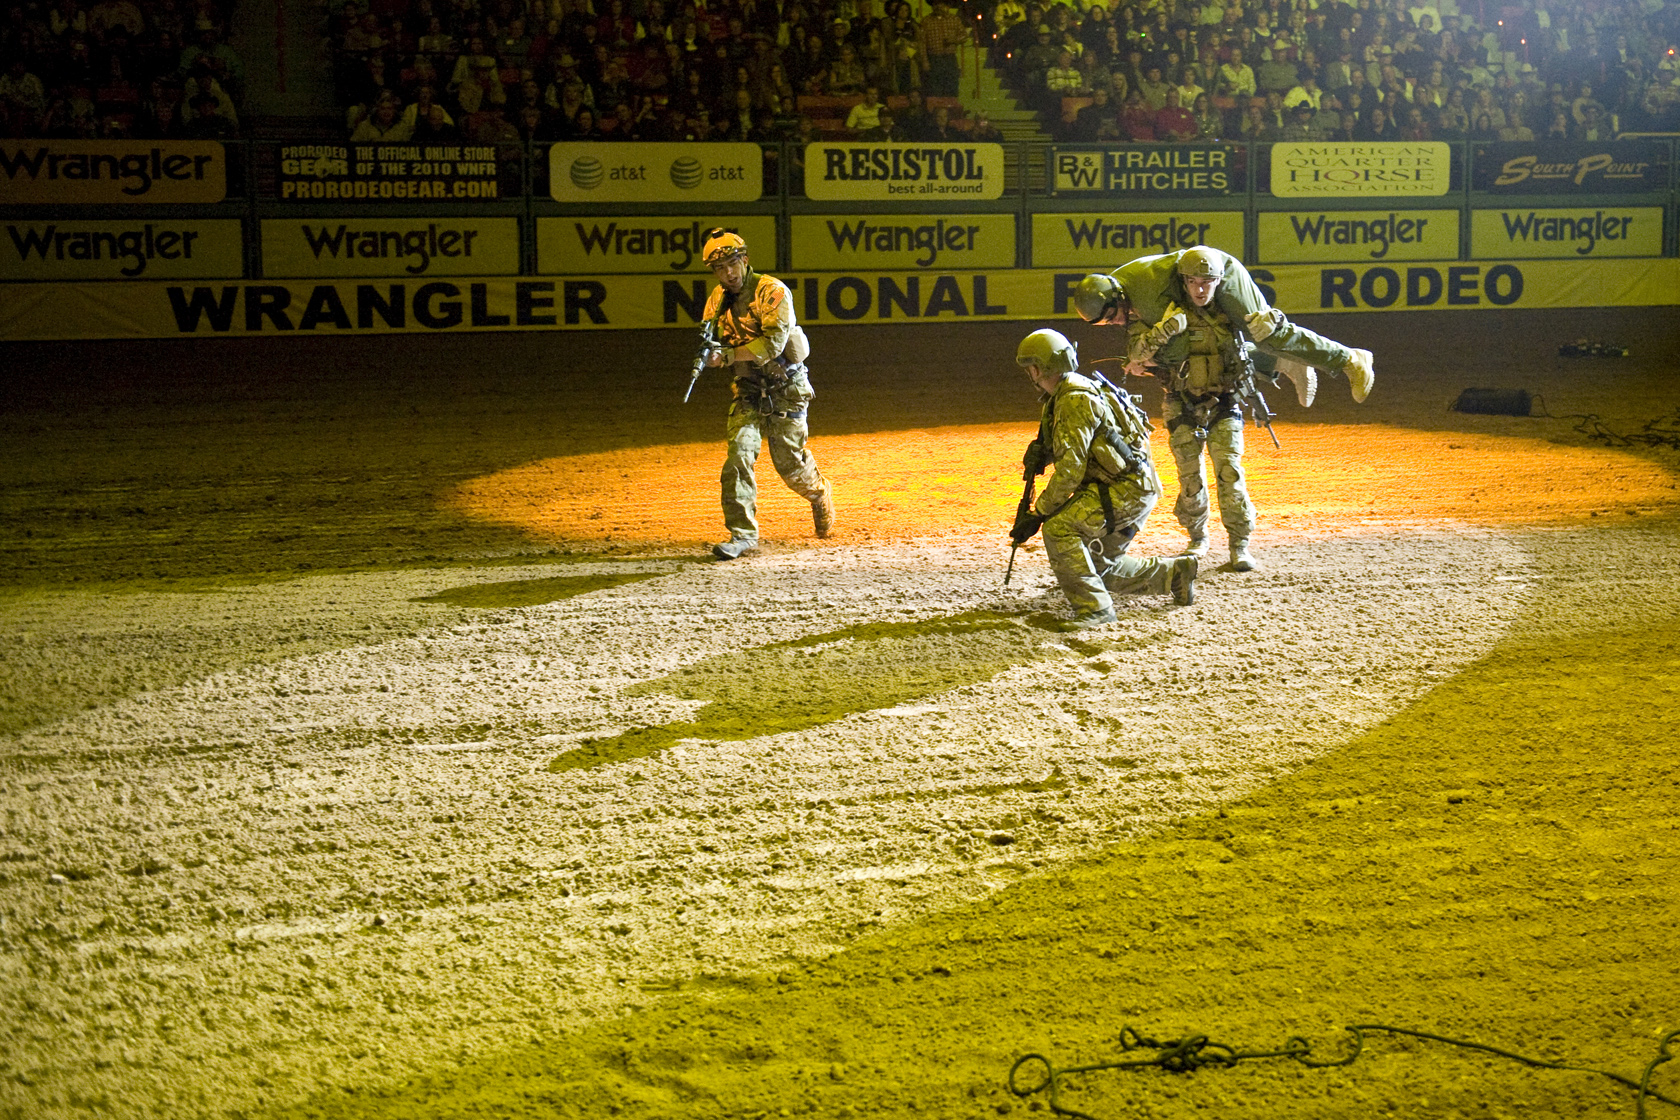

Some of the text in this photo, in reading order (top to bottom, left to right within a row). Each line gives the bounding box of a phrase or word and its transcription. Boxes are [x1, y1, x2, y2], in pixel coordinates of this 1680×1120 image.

[281, 146, 348, 160] PRORODEO
[356, 147, 496, 161] THE OFFICIAL ONLINE STORE
[1109, 151, 1226, 168] TRAILER
[1288, 147, 1434, 156] AMERICAN
[356, 162, 497, 175] OF THE 2010 WNFR
[823, 149, 983, 181] RESISTOL
[1286, 158, 1430, 168] QUARTER
[0, 148, 213, 196] Wrangler
[609, 164, 647, 181] at&t
[708, 164, 745, 181] at&t
[282, 181, 498, 198] PRORODEOGEAR.COM
[888, 183, 983, 194] best all-around
[1109, 172, 1228, 190] HITCHES
[1287, 184, 1434, 192] ASSOCIATION
[1065, 217, 1211, 255] Wrangler
[1290, 213, 1428, 258] Wrangler
[1502, 211, 1633, 255] Wrangler
[6, 224, 199, 276] Wrangler
[301, 223, 478, 274] Wrangler
[826, 219, 980, 267] Wrangler
[166, 282, 609, 332] WRANGLER
[663, 275, 1007, 323] NIONAL
[1320, 264, 1524, 308] RODEO
